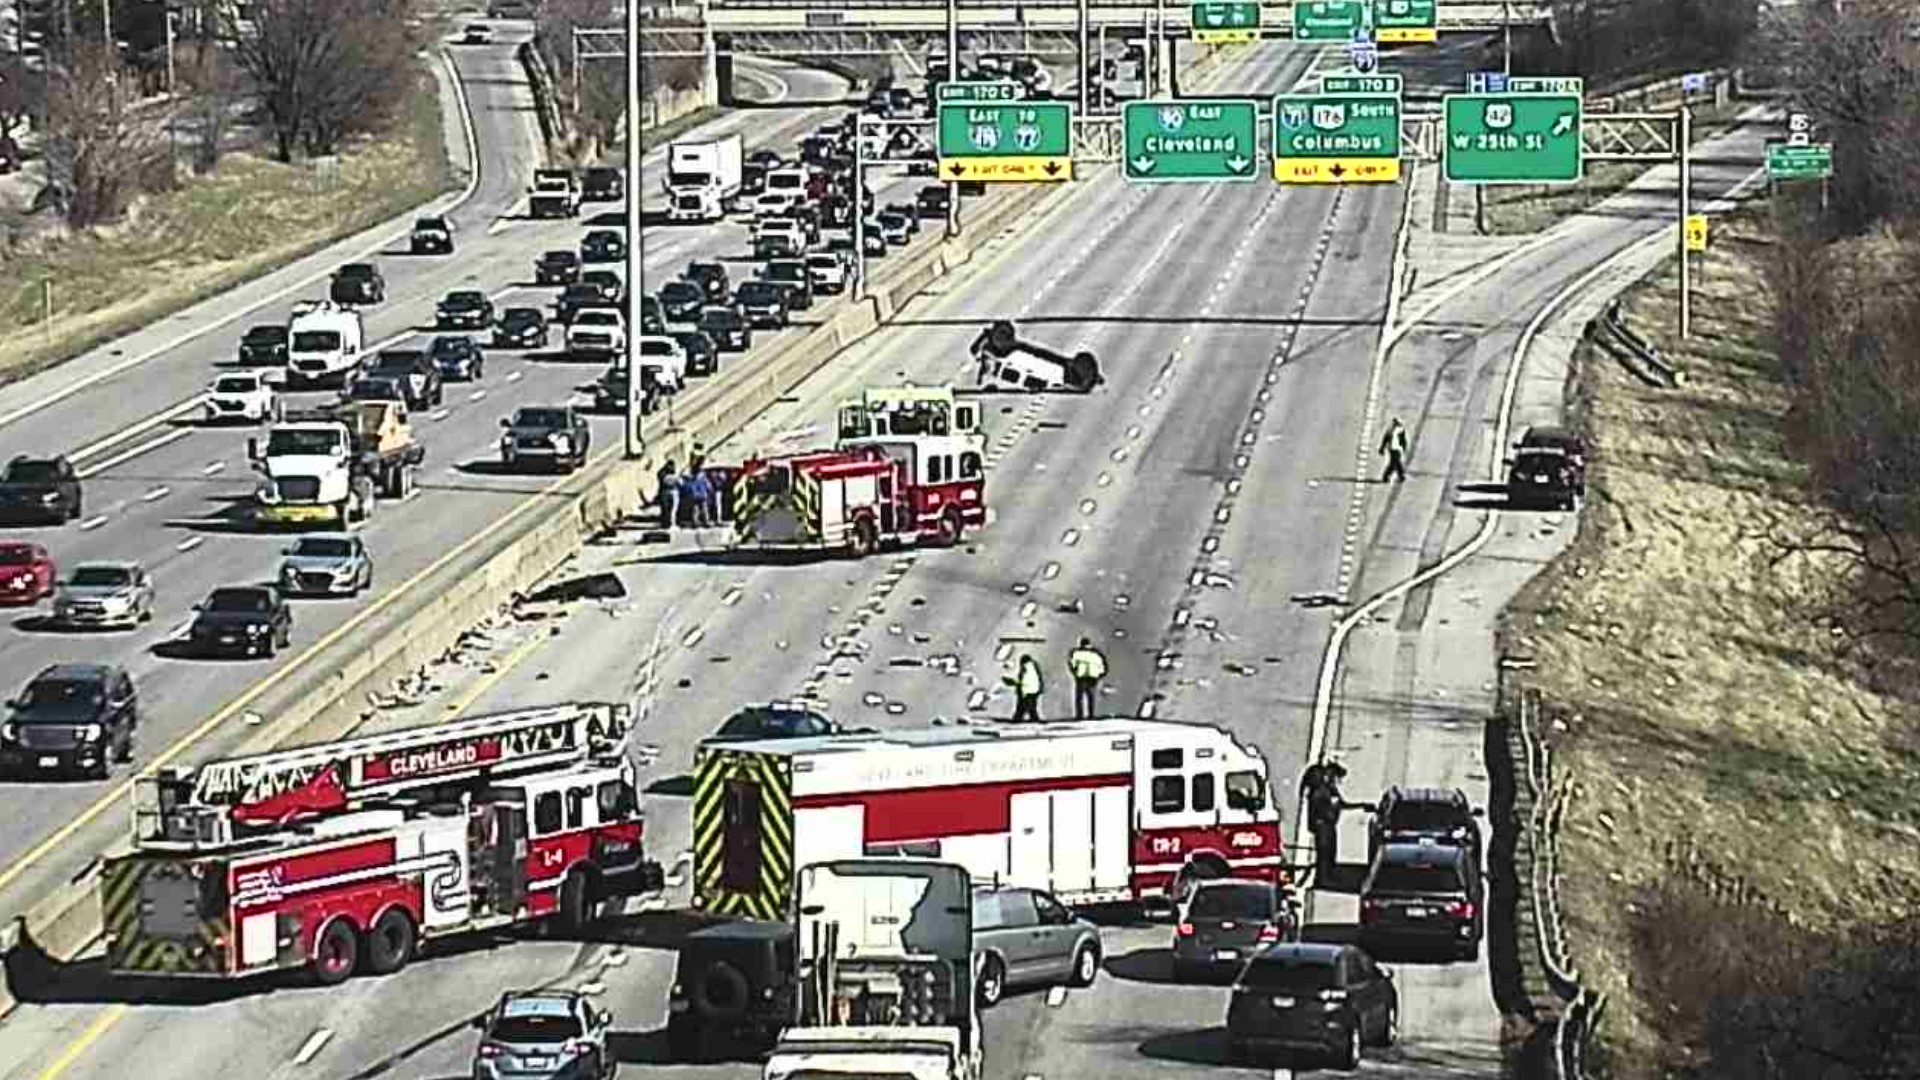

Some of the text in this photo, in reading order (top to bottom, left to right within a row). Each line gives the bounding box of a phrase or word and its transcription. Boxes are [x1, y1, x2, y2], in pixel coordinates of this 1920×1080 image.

[970, 108, 1000, 122] EAST
[1145, 136, 1236, 153] Cleveland
[1292, 135, 1383, 150] Columbus
[1452, 134, 1542, 150] W 25th St
[390, 745, 476, 775] CLEVELAND
